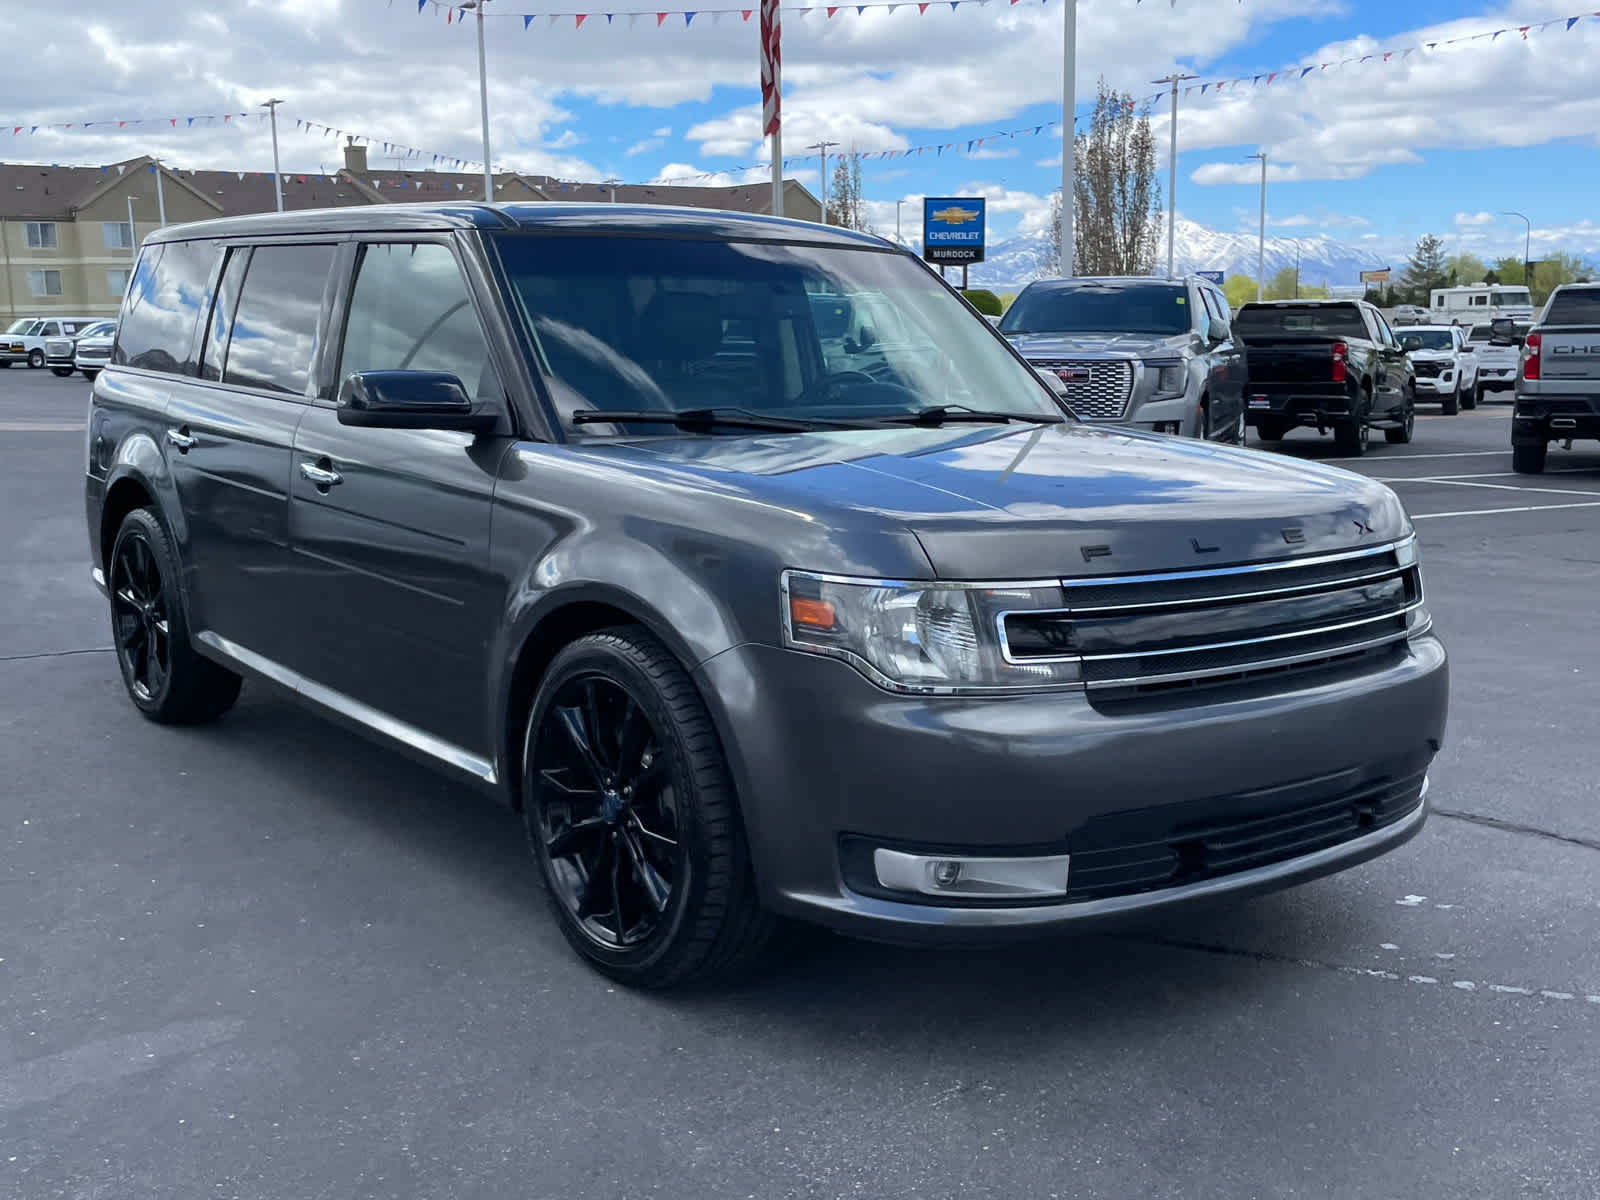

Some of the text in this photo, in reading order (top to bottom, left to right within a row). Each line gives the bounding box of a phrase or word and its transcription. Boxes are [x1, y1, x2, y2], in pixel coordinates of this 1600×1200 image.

[929, 231, 980, 240] CHEVROLET
[933, 250, 976, 258] MURDOCK
[1080, 519, 1374, 562] FLEX
